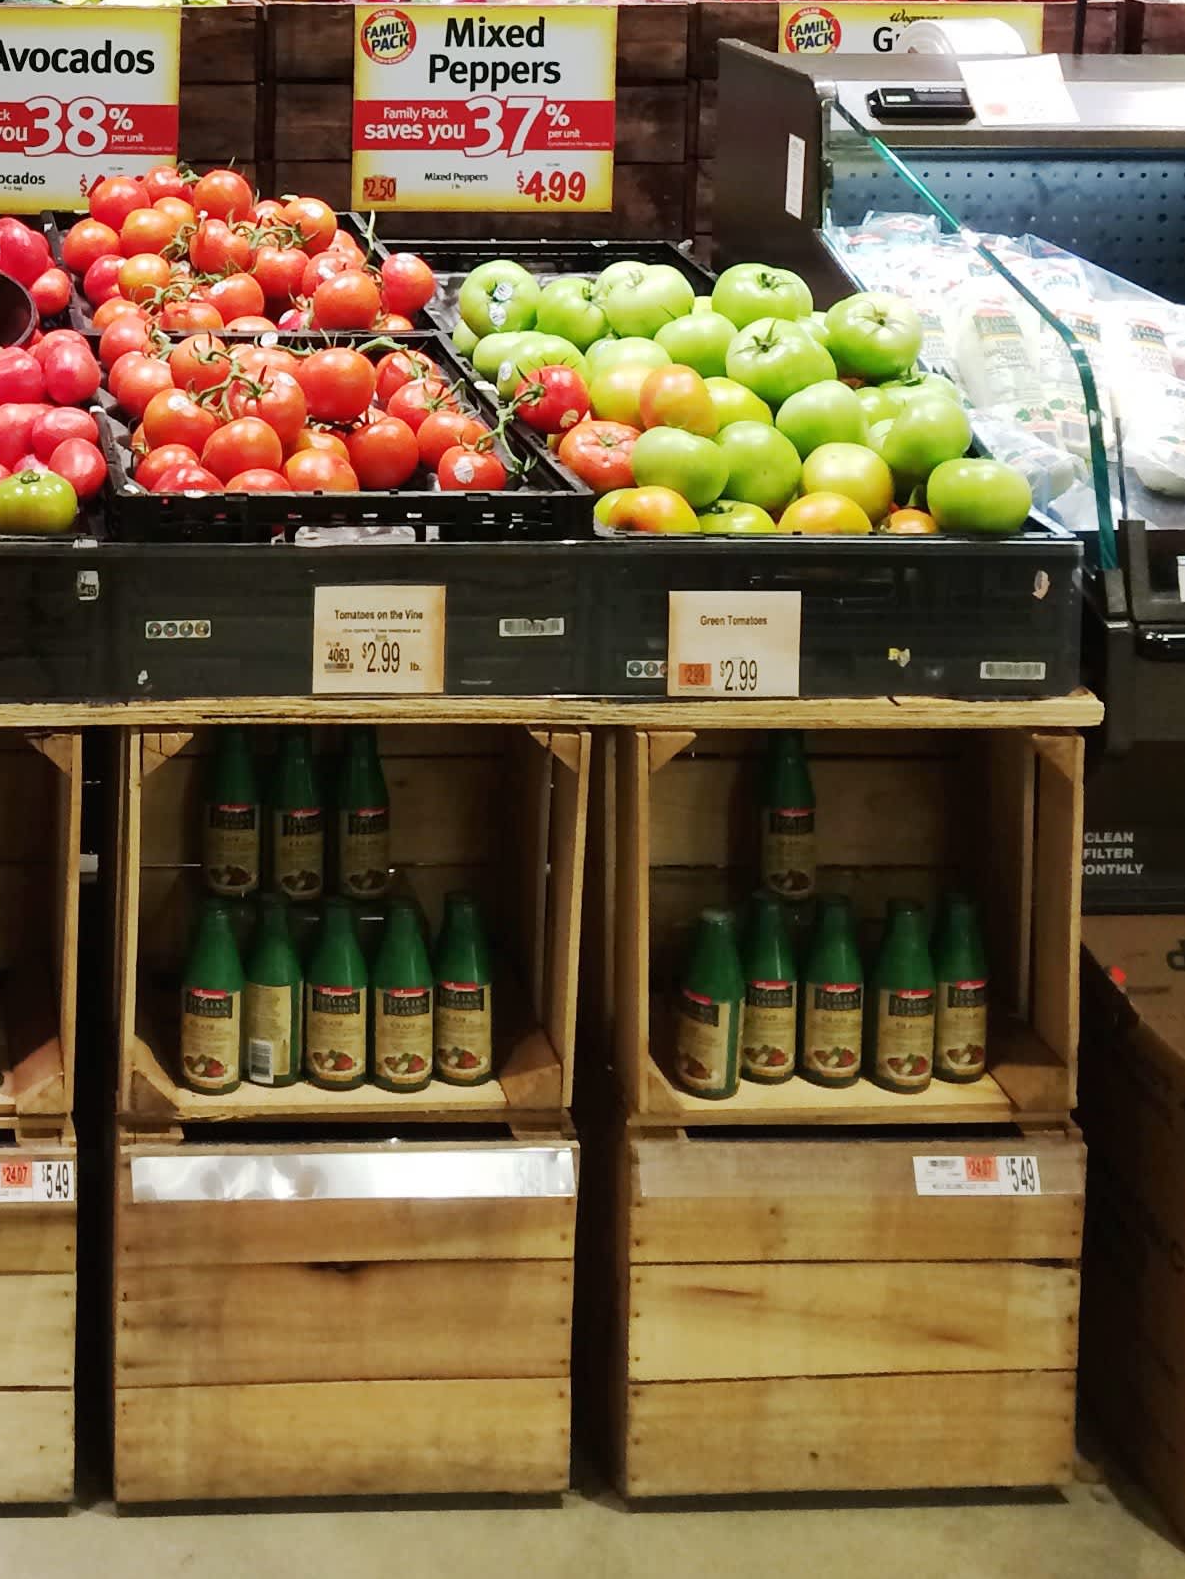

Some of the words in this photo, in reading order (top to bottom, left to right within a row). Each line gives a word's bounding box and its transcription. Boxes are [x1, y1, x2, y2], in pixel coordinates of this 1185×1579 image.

[364, 21, 409, 39] FAMILY
[444, 16, 545, 48] Mixed
[789, 18, 834, 38] FAMILY
[371, 33, 410, 53] PACK
[795, 32, 835, 50] PACK
[428, 54, 562, 92] Peppers
[383, 107, 420, 121] Family
[421, 107, 448, 120] Pack
[111, 134, 126, 143] per
[127, 132, 144, 143] unit
[364, 123, 424, 140] saves
[428, 124, 466, 145] you
[547, 130, 562, 140] per
[563, 128, 581, 139] unit
[424, 172, 451, 182] Mixed
[453, 172, 489, 183] Peppers
[364, 179, 397, 198] $2.50
[516, 170, 586, 204] $4.99
[334, 609, 375, 620] Tomatoes
[377, 611, 388, 620] on
[390, 609, 404, 620] the
[405, 609, 423, 620] Vine
[700, 615, 725, 626] Green
[727, 615, 768, 626] Tomatoes
[327, 648, 350, 662] 4063
[361, 641, 401, 673] $2.99
[409, 661, 422, 671] lb.
[719, 660, 758, 691] $2.99
[1084, 832, 1134, 843] CLEAN
[1083, 848, 1134, 860] FILTER
